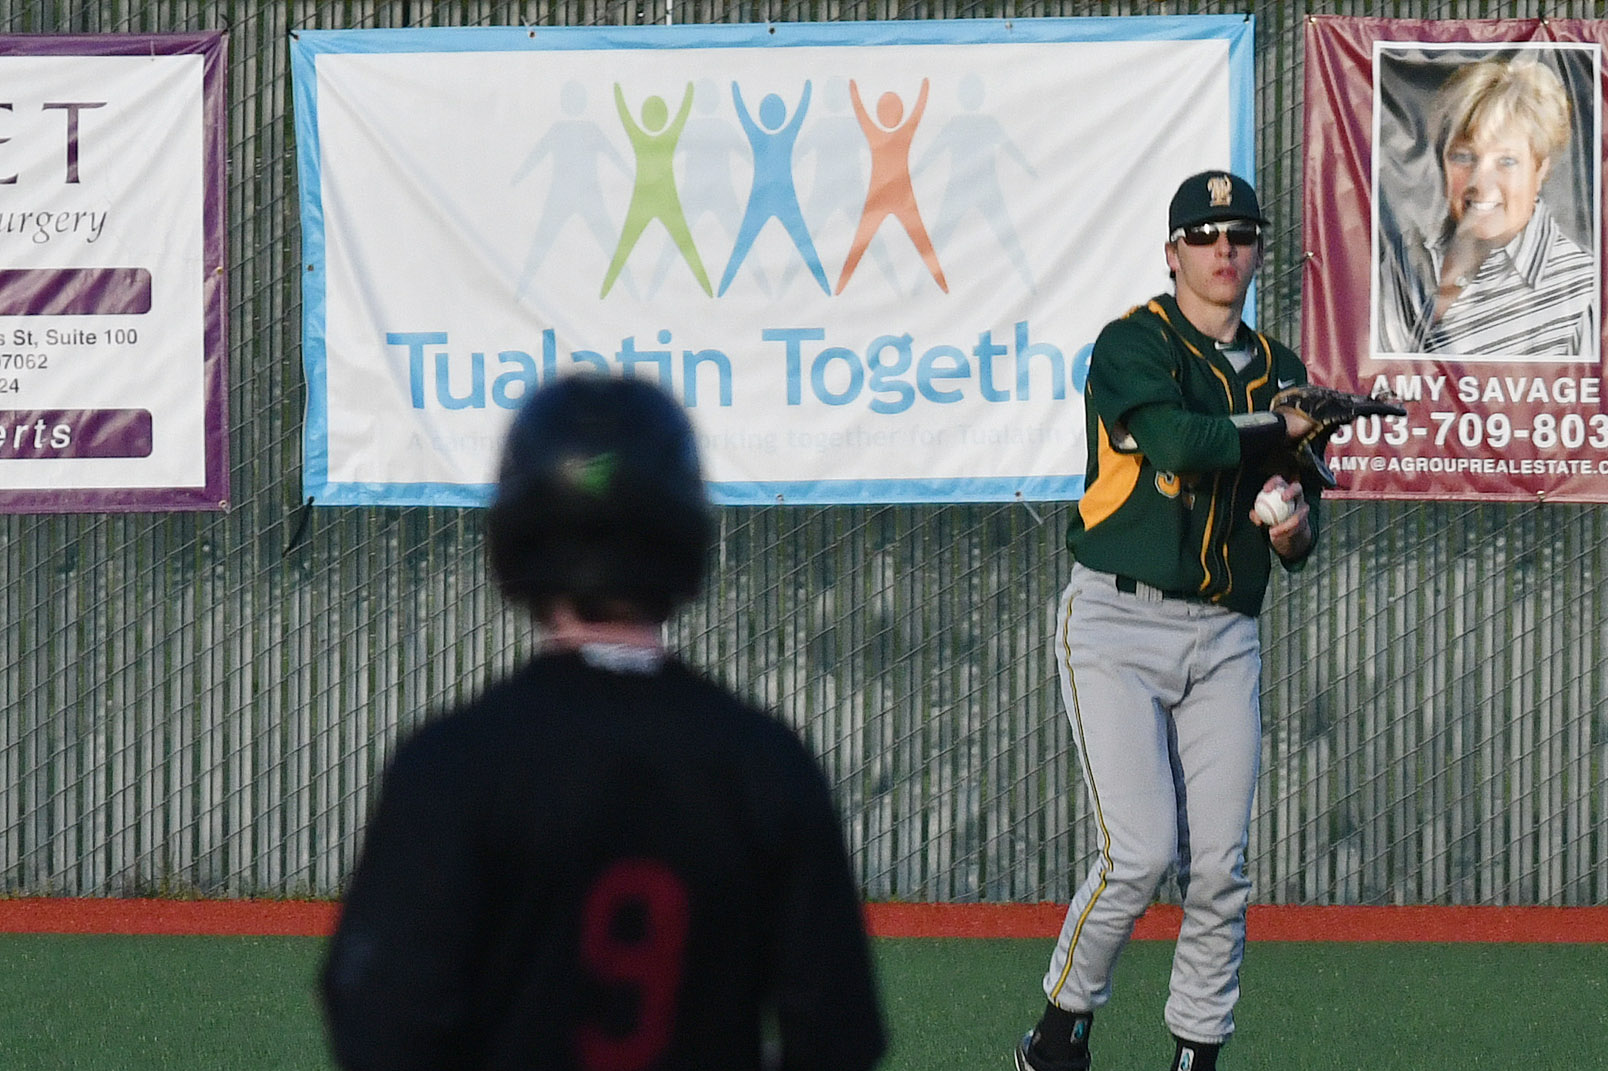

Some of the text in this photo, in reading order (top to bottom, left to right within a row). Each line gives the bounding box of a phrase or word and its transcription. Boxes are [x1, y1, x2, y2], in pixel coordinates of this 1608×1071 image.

[13, 329, 39, 348] St,
[46, 328, 97, 346] Suite
[104, 328, 138, 345] 100
[1371, 374, 1601, 404] AMY SAVAGE
[786, 423, 901, 455] together
